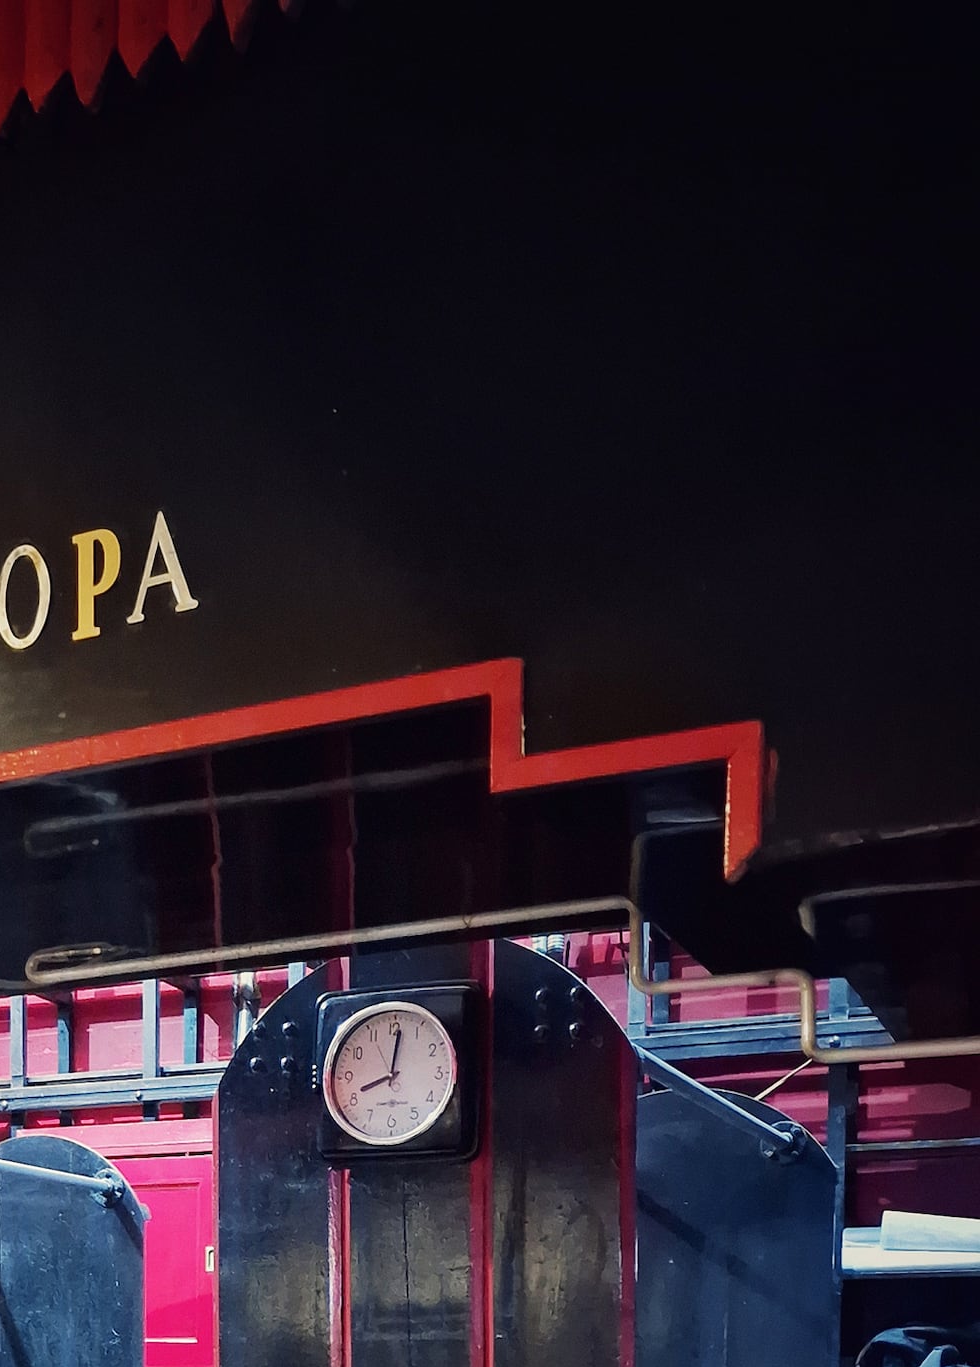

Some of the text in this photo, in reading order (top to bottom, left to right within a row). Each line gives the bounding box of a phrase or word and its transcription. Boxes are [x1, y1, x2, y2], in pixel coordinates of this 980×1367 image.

[369, 1030, 378, 1042] 11
[415, 1026, 419, 1039] 1
[353, 1046, 363, 1060] 10
[428, 1043, 437, 1057] 2
[344, 1070, 353, 1084] 9
[434, 1066, 444, 1080] 3
[349, 1092, 358, 1106] 8
[426, 1091, 434, 1103] 4
[366, 1109, 374, 1122] 7
[409, 1107, 419, 1120] 5
[387, 1114, 397, 1128] 6
